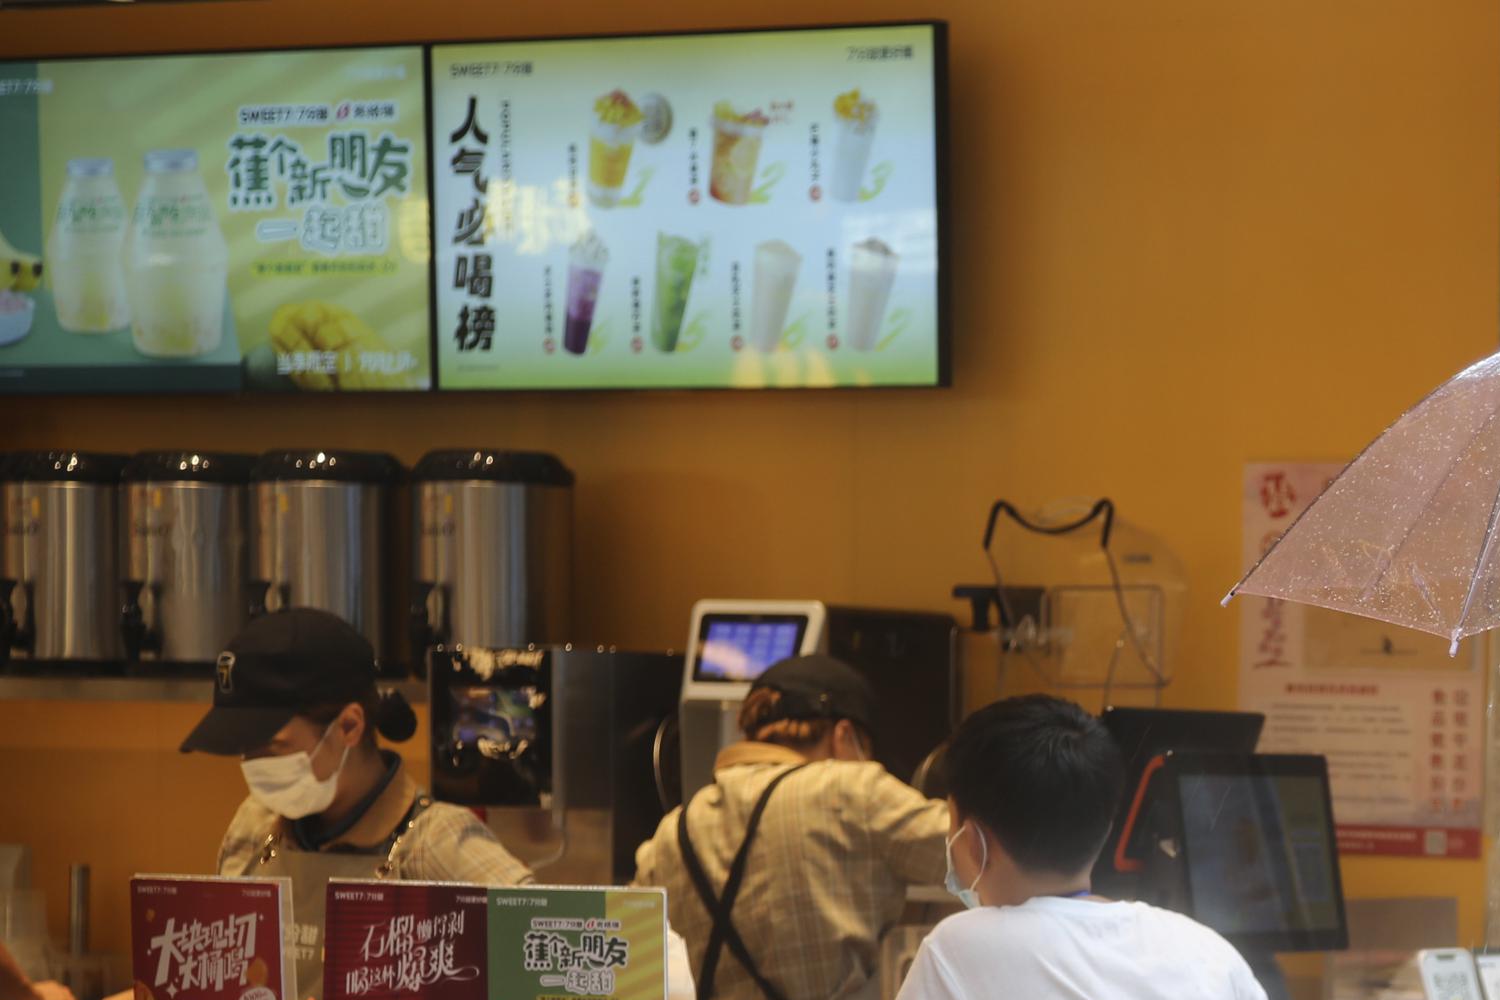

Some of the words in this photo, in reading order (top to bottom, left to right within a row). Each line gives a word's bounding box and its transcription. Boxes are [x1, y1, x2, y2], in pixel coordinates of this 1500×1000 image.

[228, 132, 411, 207] 蕉个新朋友
[450, 96, 496, 352] 人气必喝榜
[335, 891, 363, 901] SWEET7
[496, 896, 527, 906] SWEET7
[525, 932, 629, 970] 蕉个新朋友
[540, 969, 615, 995] 一起甜
